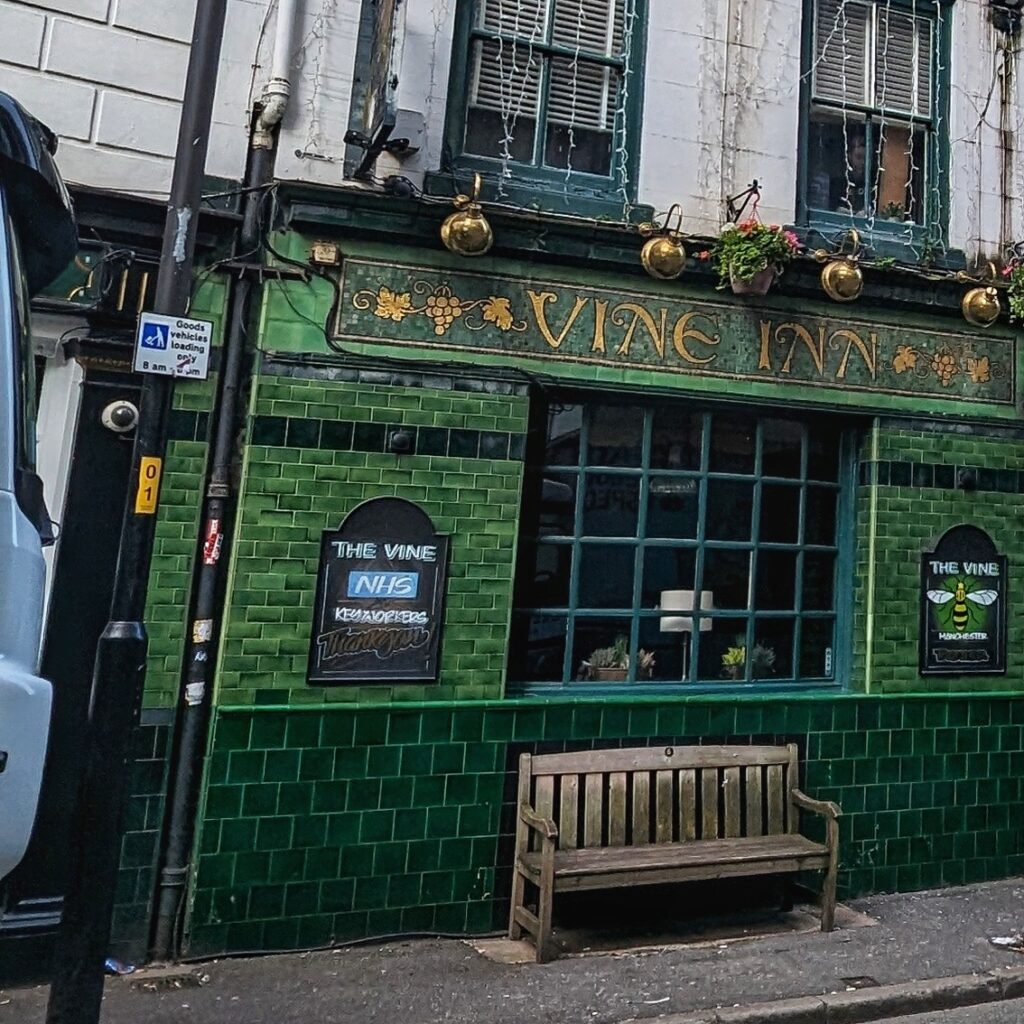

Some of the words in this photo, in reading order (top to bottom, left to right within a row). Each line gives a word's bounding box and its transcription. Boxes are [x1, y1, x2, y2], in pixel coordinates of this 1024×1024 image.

[176, 320, 205, 332] Goods
[170, 331, 208, 343] vehicles
[526, 289, 721, 364] VINE
[758, 319, 878, 380] INN
[171, 341, 205, 354] loading
[142, 361, 149, 369] 8
[331, 541, 377, 559] THE
[384, 543, 437, 562] VINE
[929, 561, 960, 575] THE
[963, 562, 1000, 577] VINE
[354, 575, 413, 595] NHS
